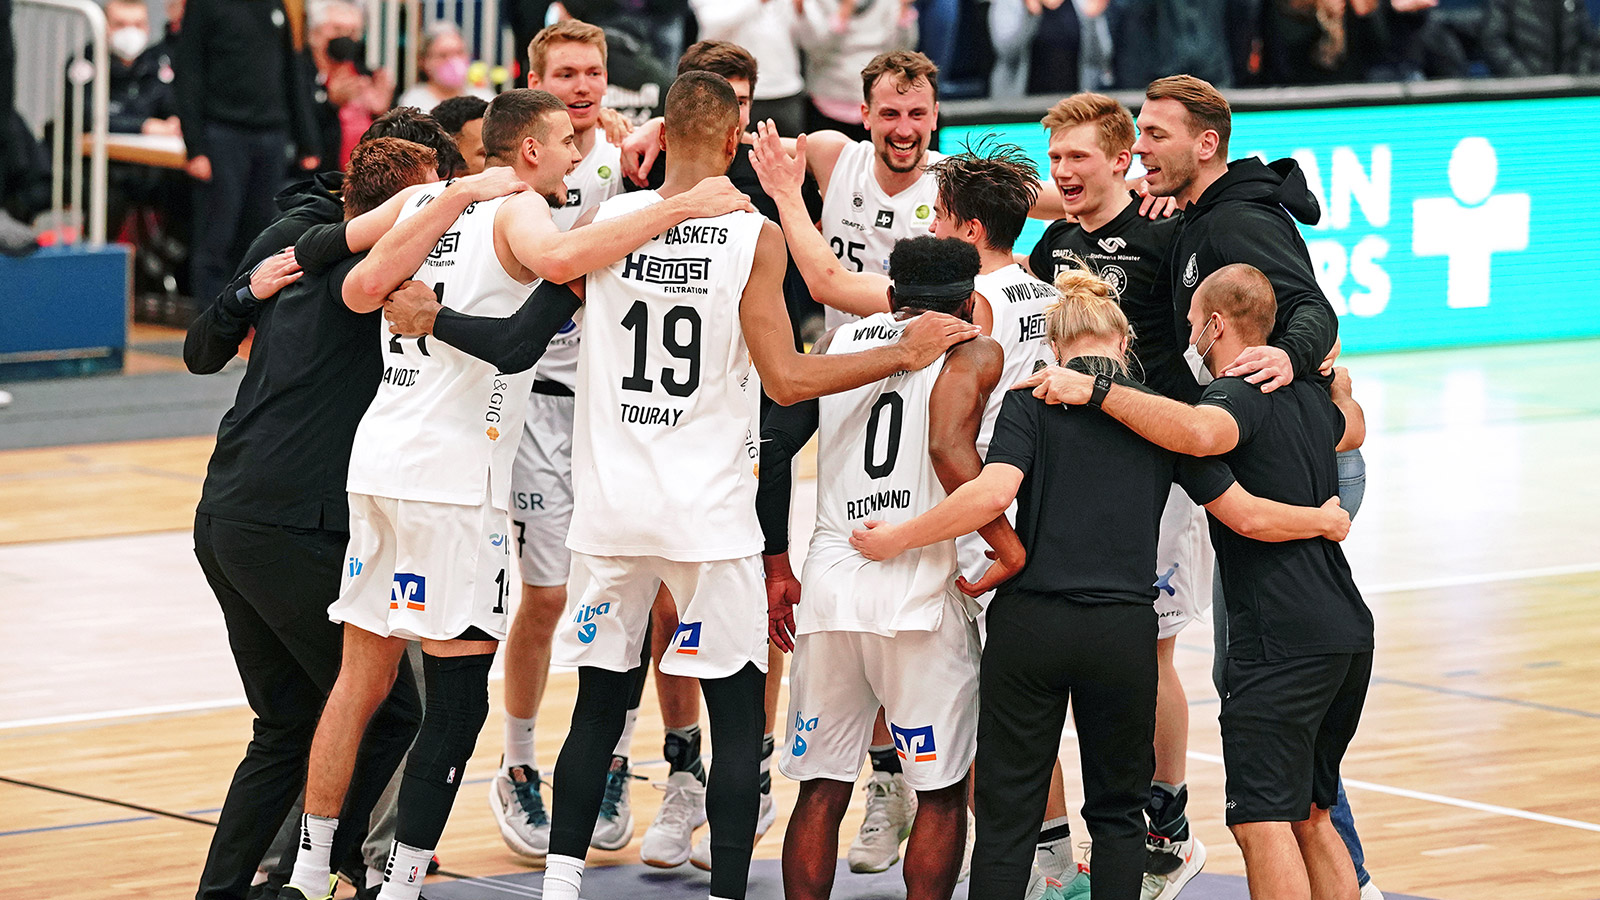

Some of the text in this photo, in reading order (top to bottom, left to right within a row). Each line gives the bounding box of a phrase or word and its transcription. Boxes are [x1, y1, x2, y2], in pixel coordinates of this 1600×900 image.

[664, 226, 728, 245] BASKETS
[622, 252, 712, 284] Hengst
[664, 286, 708, 295] FILTRATION
[1001, 283, 1031, 303] WWU
[620, 300, 702, 397] 19
[383, 366, 419, 387] AVDIC
[620, 404, 683, 426] TOURAY
[864, 391, 903, 479] 0
[512, 491, 545, 511] ISR
[847, 490, 911, 520] RICHMOND
